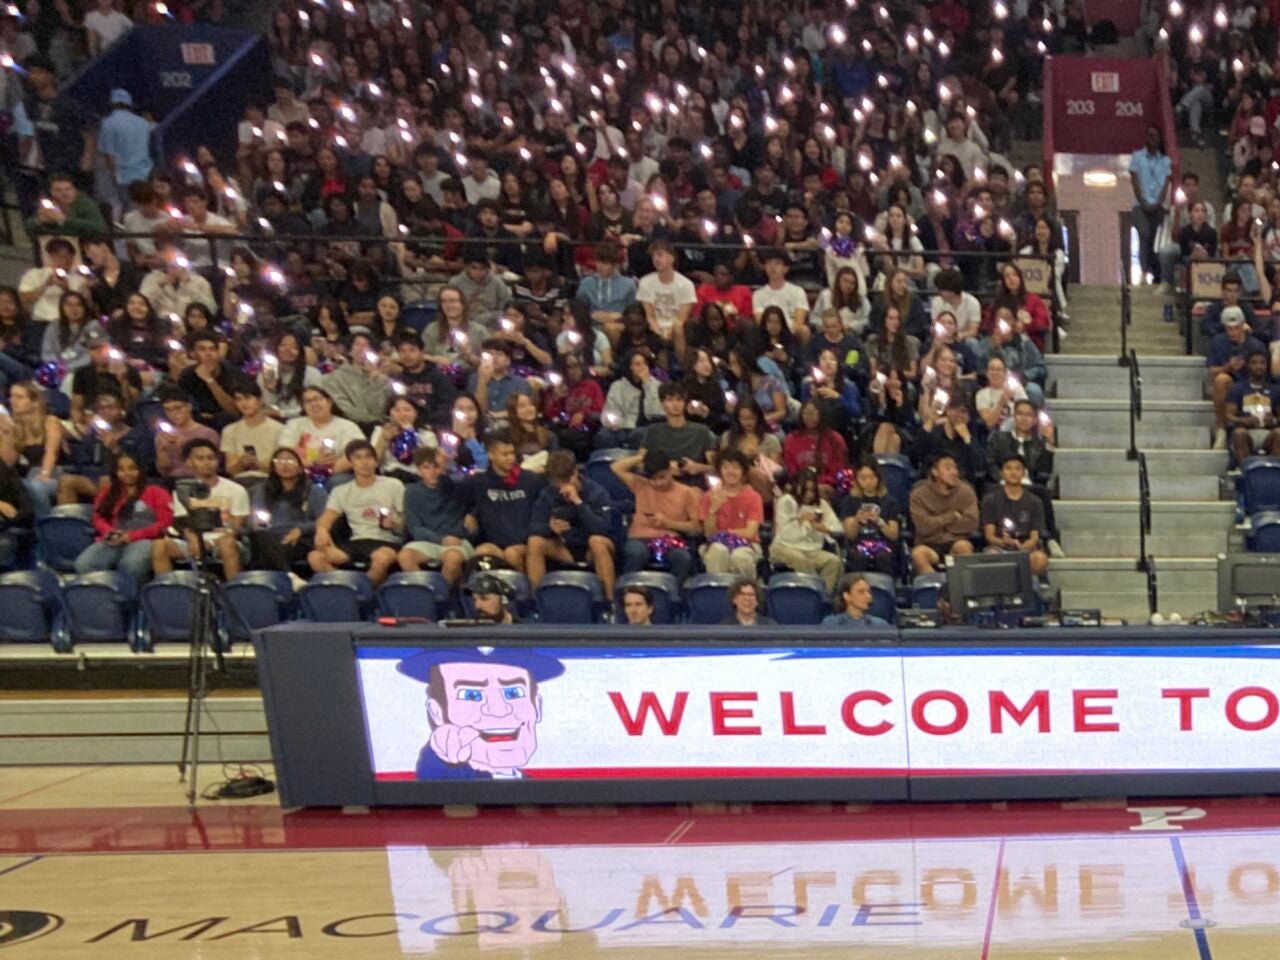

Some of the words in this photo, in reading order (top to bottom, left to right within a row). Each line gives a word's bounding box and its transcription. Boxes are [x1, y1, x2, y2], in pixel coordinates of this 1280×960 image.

[161, 71, 192, 87] 202
[1066, 99, 1095, 115] 203
[1115, 101, 1143, 117] 204
[1198, 272, 1220, 285] 104
[610, 689, 1121, 737] WELCOME
[1162, 686, 1280, 732] TO
[1126, 806, 1207, 830] P
[84, 903, 928, 944] MACQUARIE
